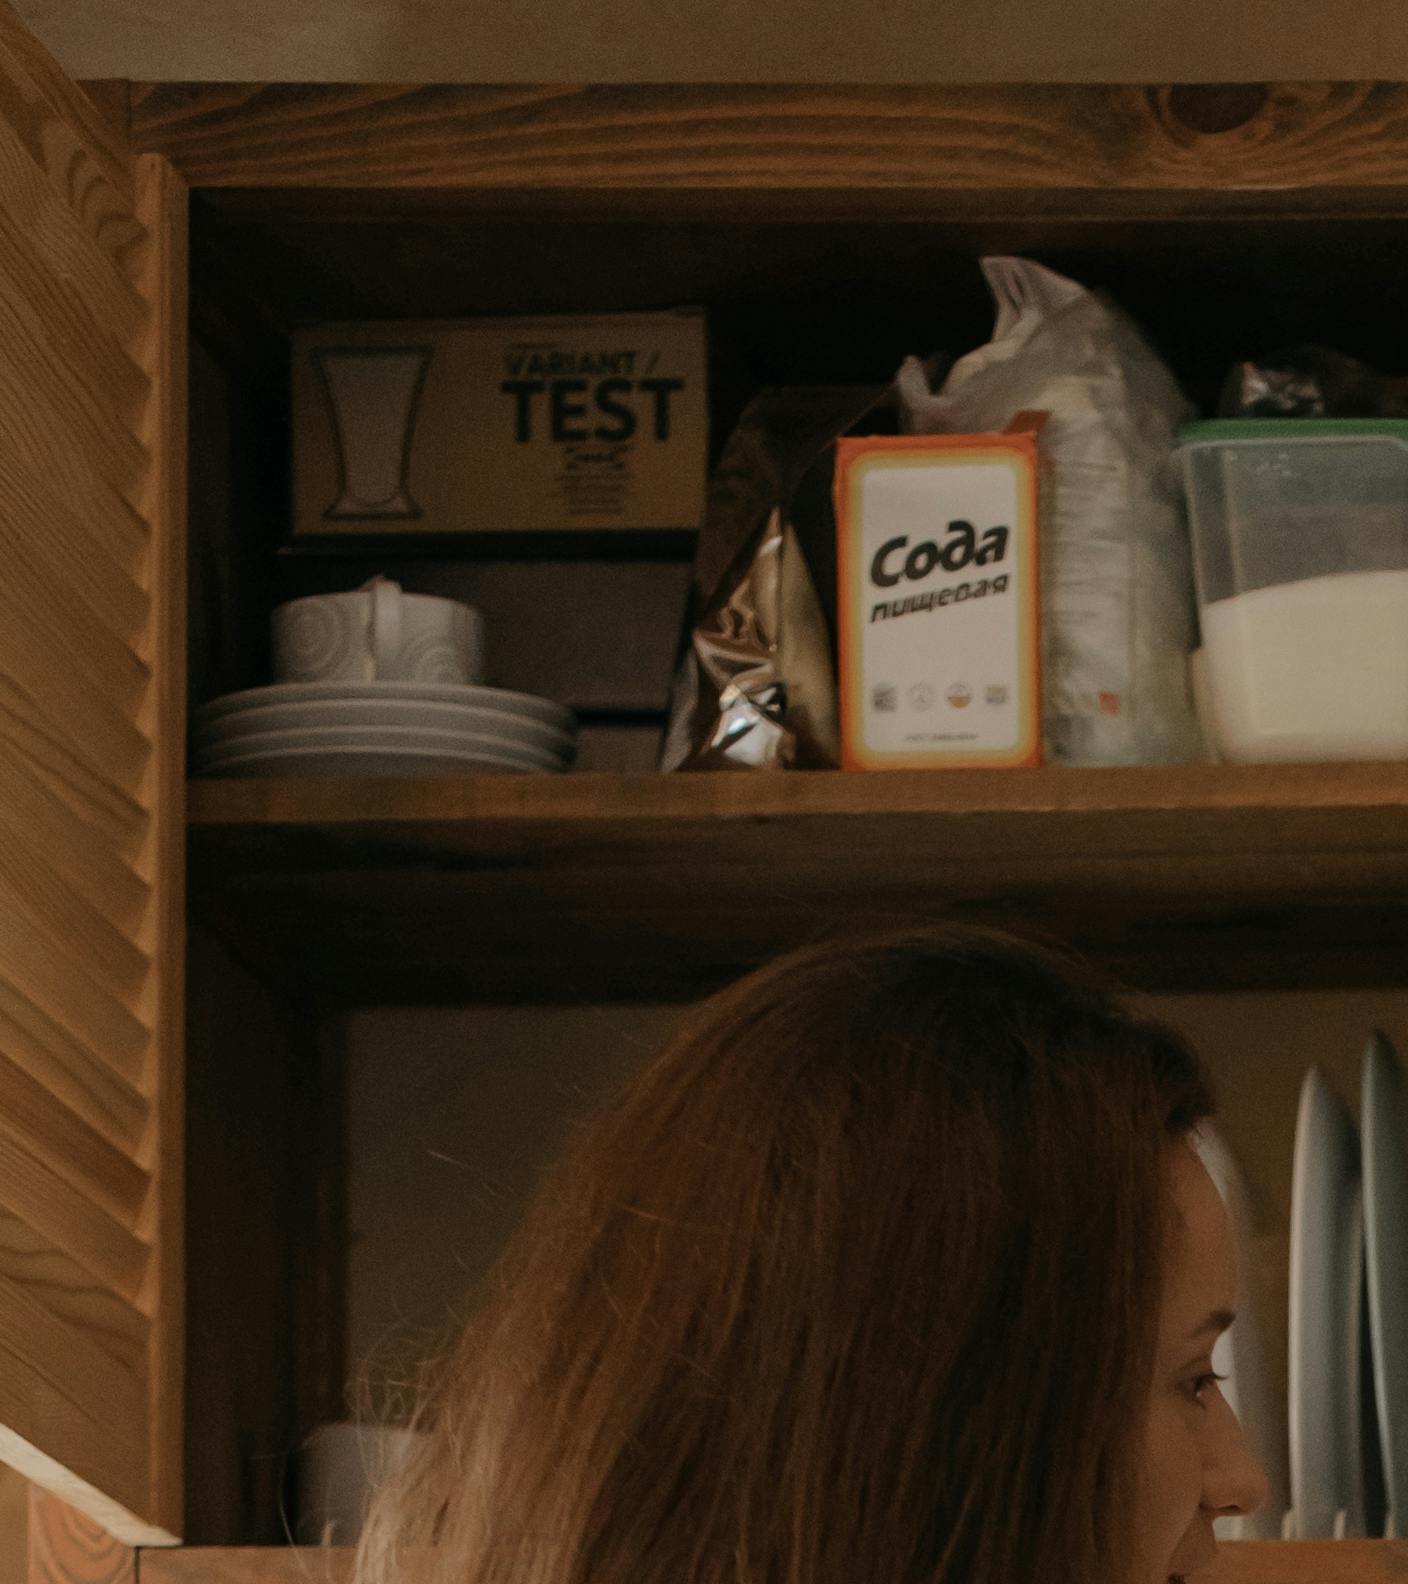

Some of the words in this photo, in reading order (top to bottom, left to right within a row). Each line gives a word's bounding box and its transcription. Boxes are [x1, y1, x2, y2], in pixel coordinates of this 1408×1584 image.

[501, 378, 684, 443] TEST
[870, 519, 1009, 588] Сода
[870, 573, 1010, 623] пищевая
